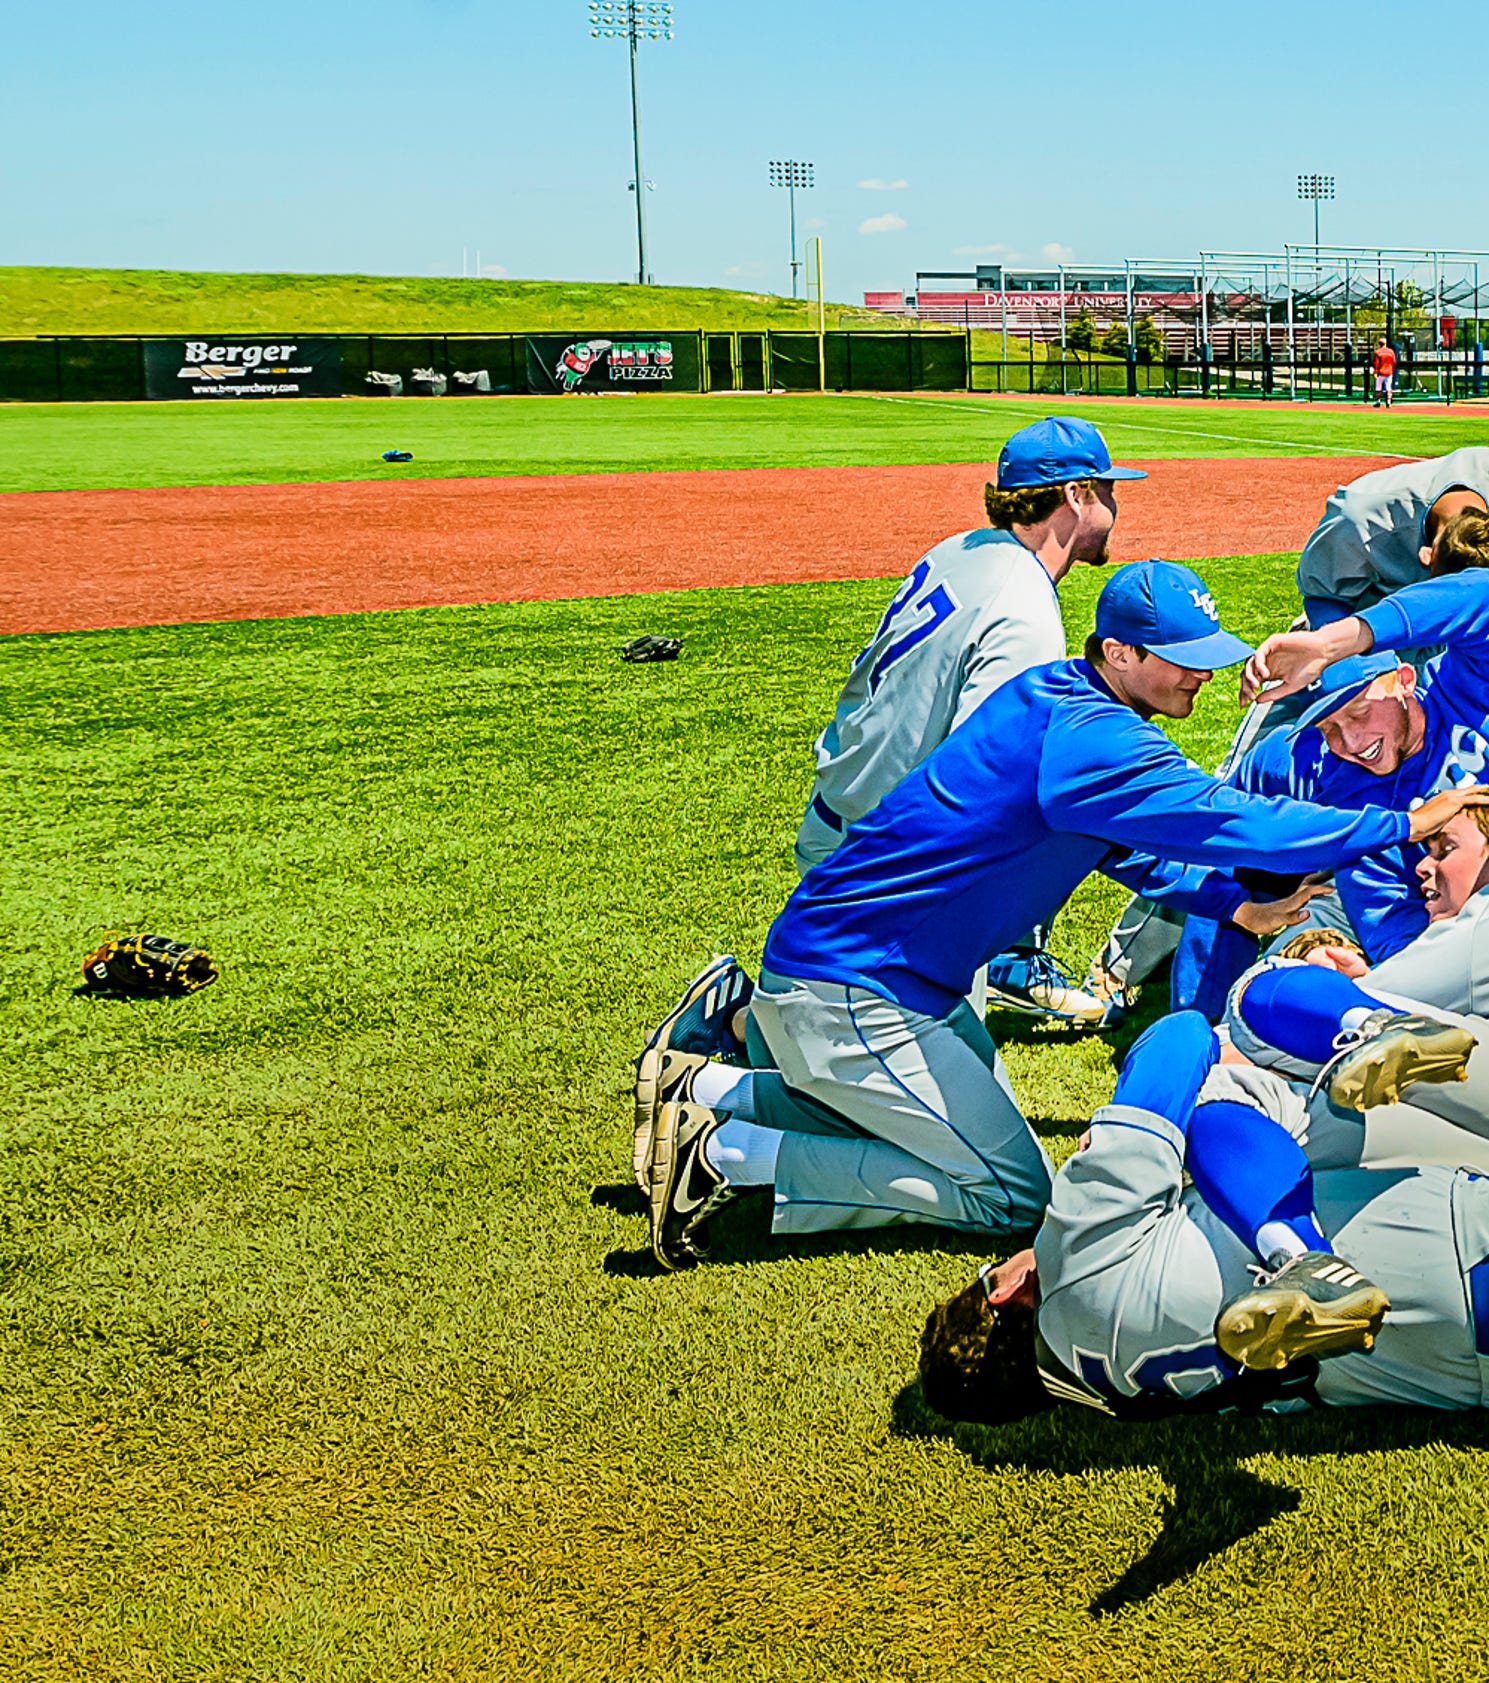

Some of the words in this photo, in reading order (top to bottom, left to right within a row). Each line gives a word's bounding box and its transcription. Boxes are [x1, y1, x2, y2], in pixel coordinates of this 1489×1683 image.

[1074, 295, 1152, 307] UNIVERITY
[185, 341, 298, 367] Berger
[607, 341, 673, 365] JET'S
[609, 366, 673, 380] PIZZA
